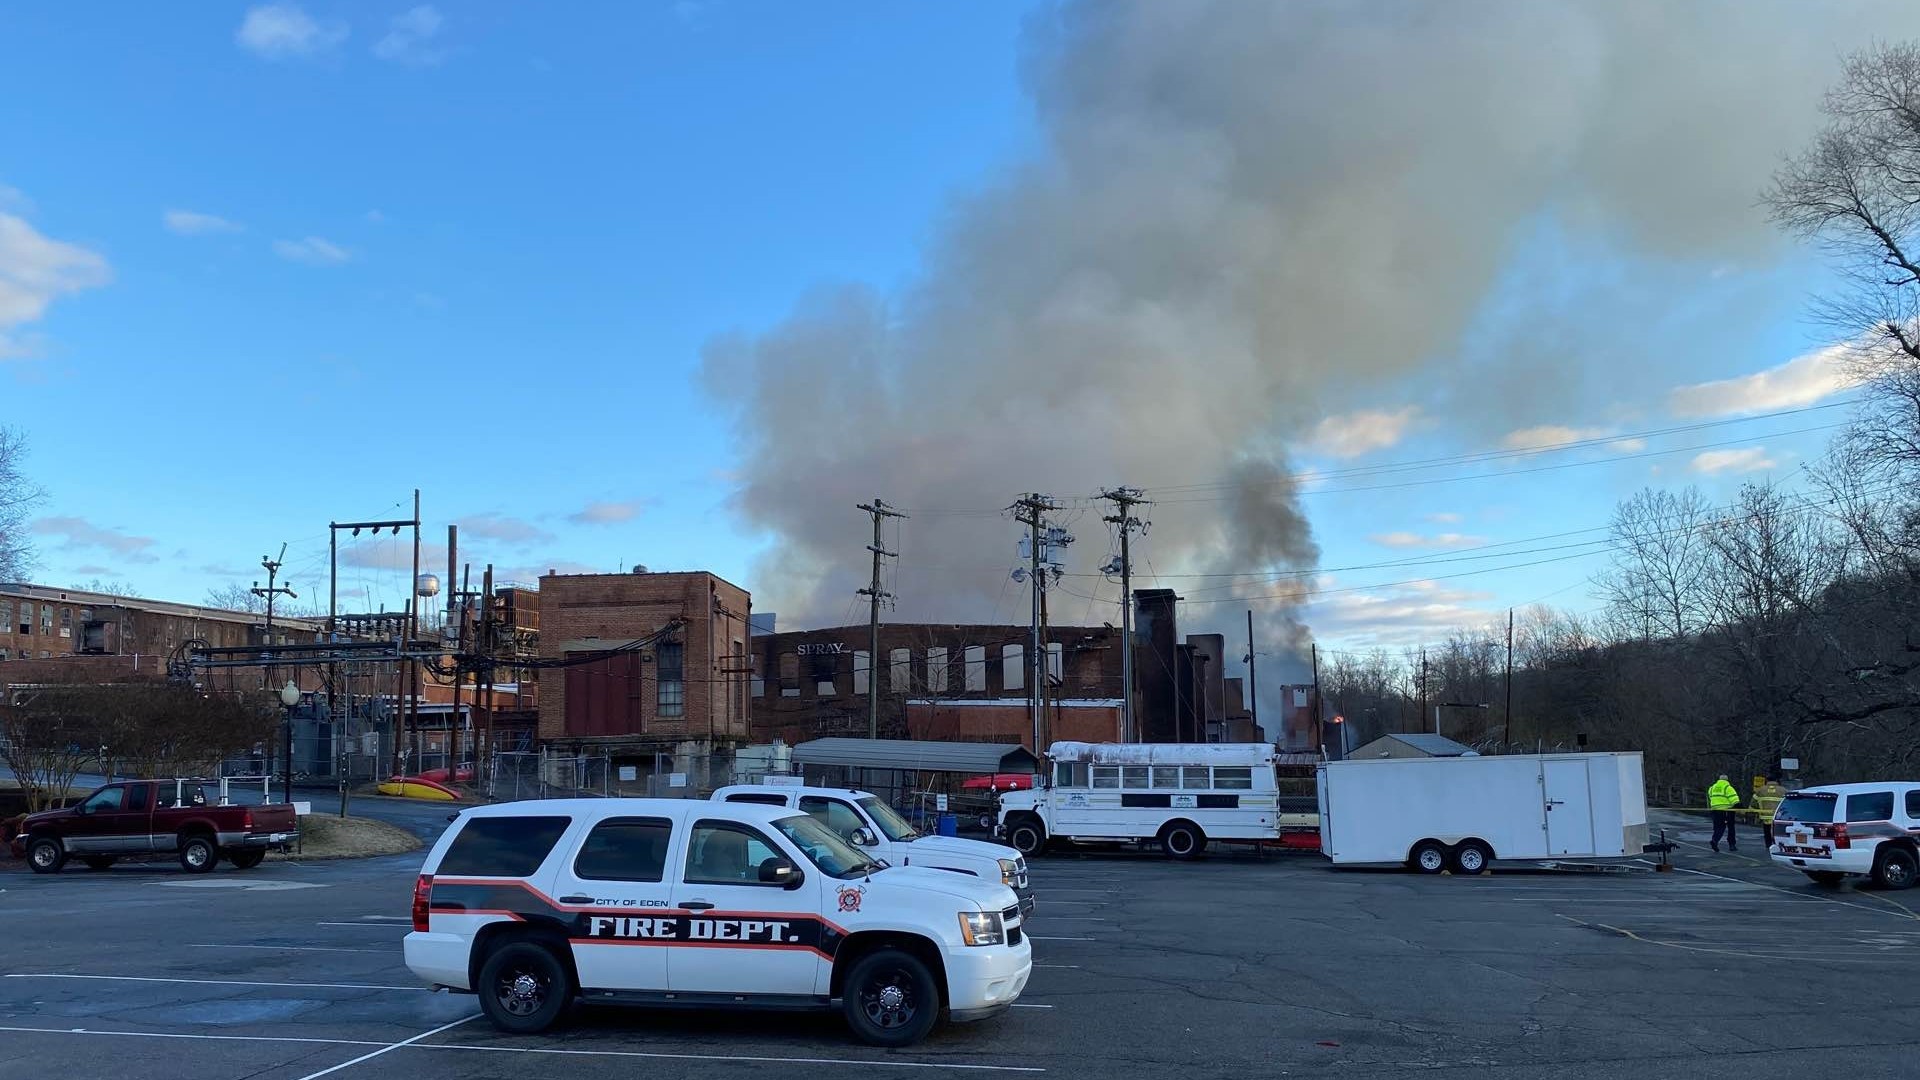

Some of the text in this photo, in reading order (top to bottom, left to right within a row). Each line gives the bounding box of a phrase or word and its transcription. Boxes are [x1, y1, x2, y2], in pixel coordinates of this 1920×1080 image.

[797, 643, 844, 655] SPRAY
[589, 916, 799, 942] FIRE DEPT.
